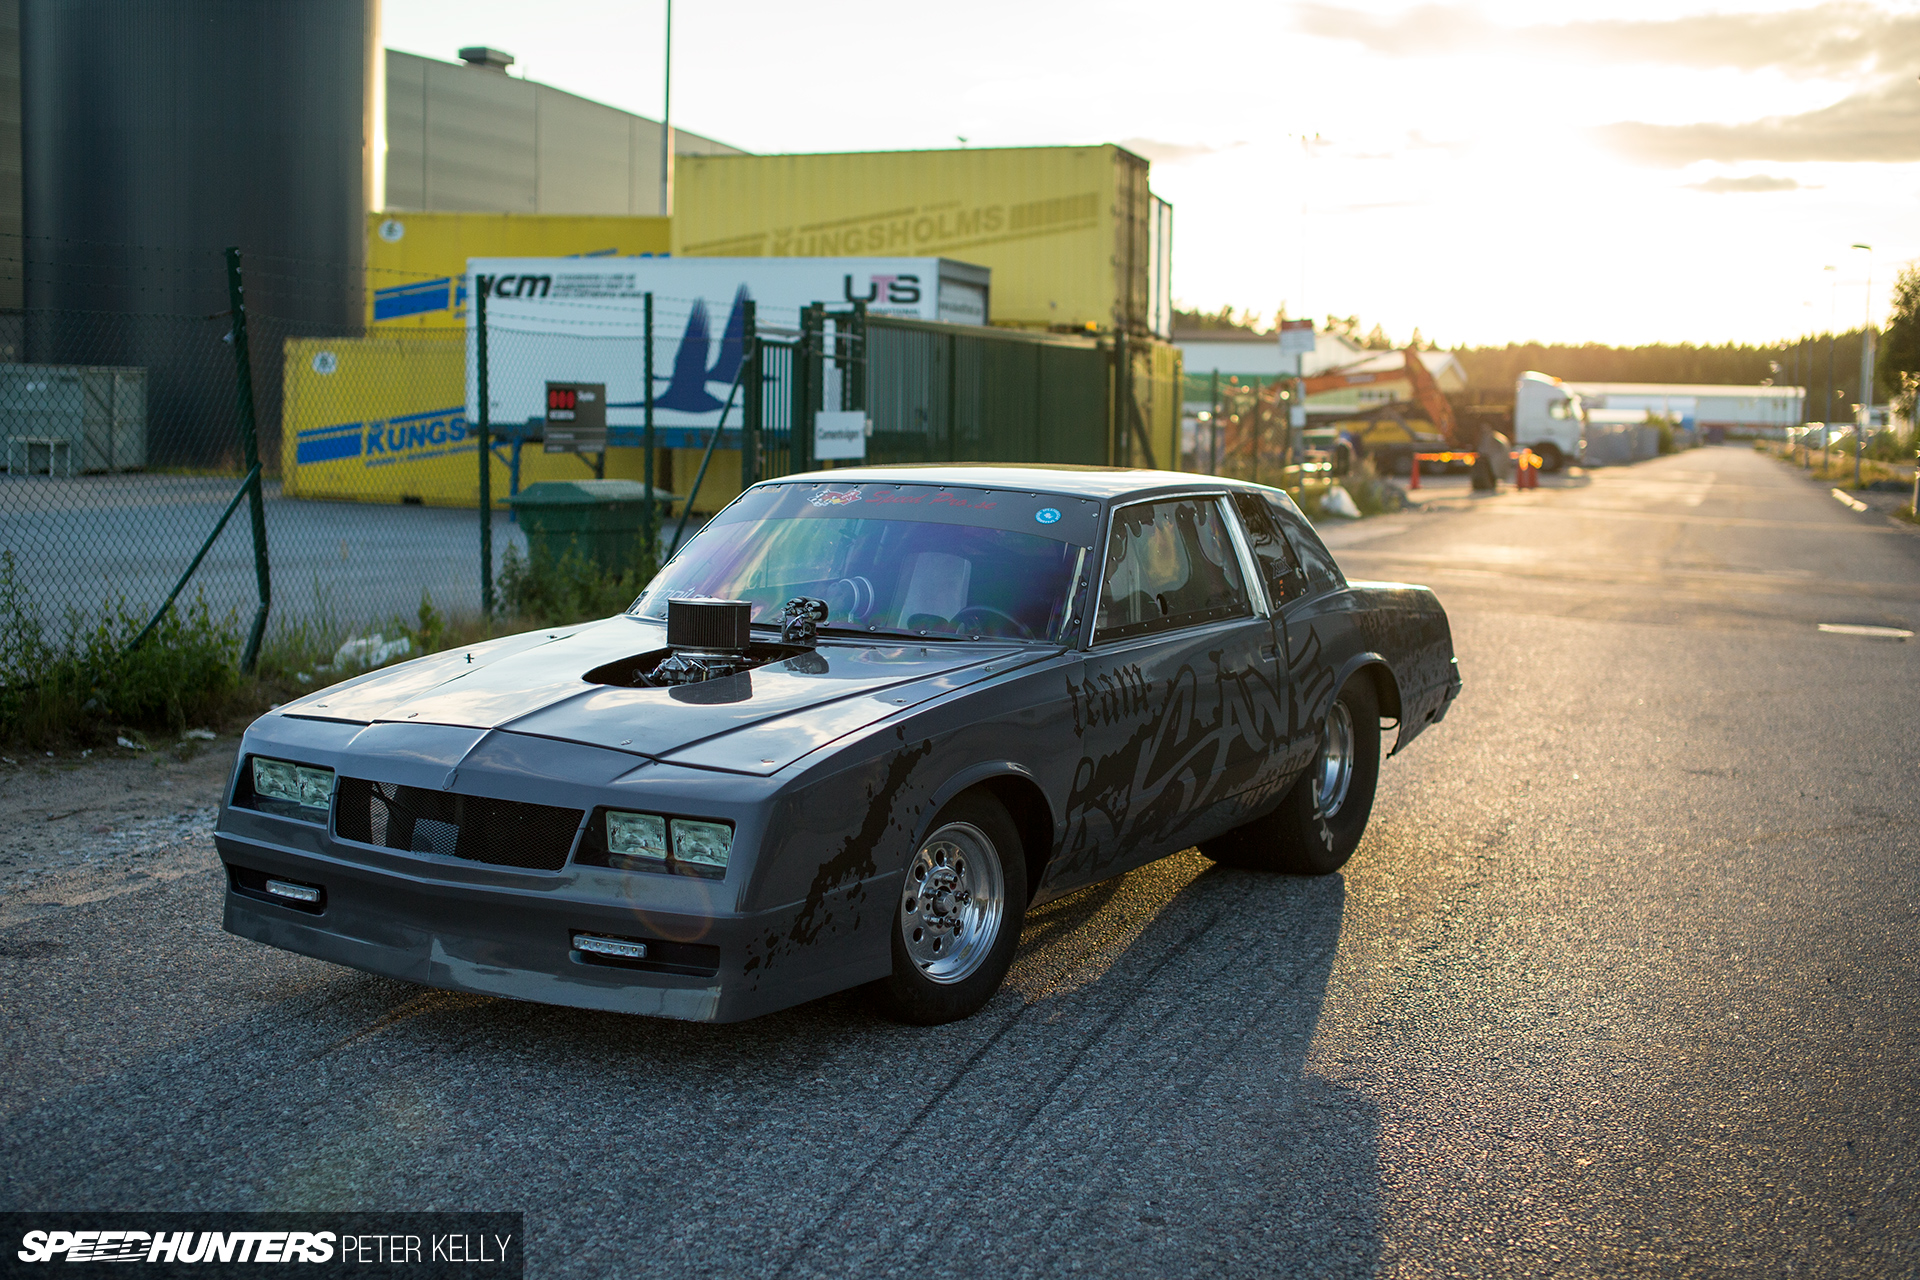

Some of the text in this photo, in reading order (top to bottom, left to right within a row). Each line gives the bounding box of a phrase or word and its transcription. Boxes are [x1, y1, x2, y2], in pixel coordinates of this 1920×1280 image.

[771, 205, 1005, 257] KUNGSHOLMS
[844, 273, 921, 303] UTS
[866, 490, 928, 507] Speed
